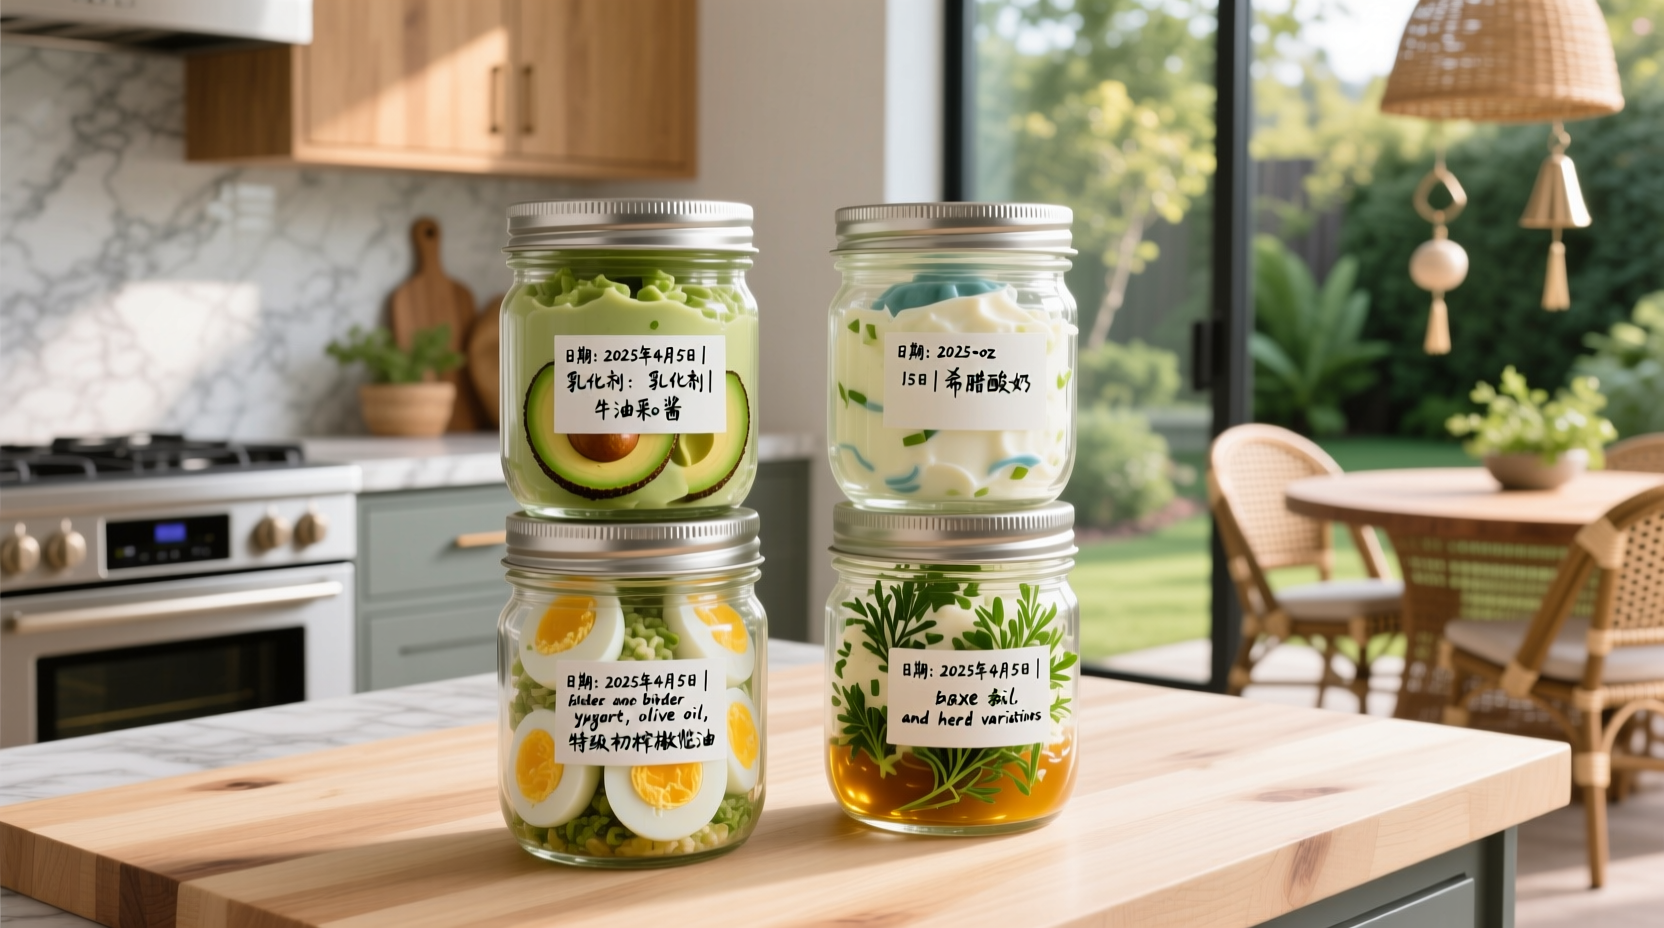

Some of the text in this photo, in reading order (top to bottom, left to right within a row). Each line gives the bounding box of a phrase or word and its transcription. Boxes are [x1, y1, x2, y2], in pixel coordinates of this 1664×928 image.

[566, 346, 597, 364] 日期:
[604, 345, 694, 365] 2025年4月5日
[898, 342, 929, 360] 日期:
[945, 367, 1030, 398] 希腊酸奶
[903, 661, 933, 679] 日期:
[940, 662, 1029, 680] 2025年4月5日
[567, 672, 598, 690] 日期:
[605, 673, 696, 691] 2025年4月5日
[639, 707, 674, 722] olive
[684, 704, 707, 722] oil,
[902, 710, 929, 724] and
